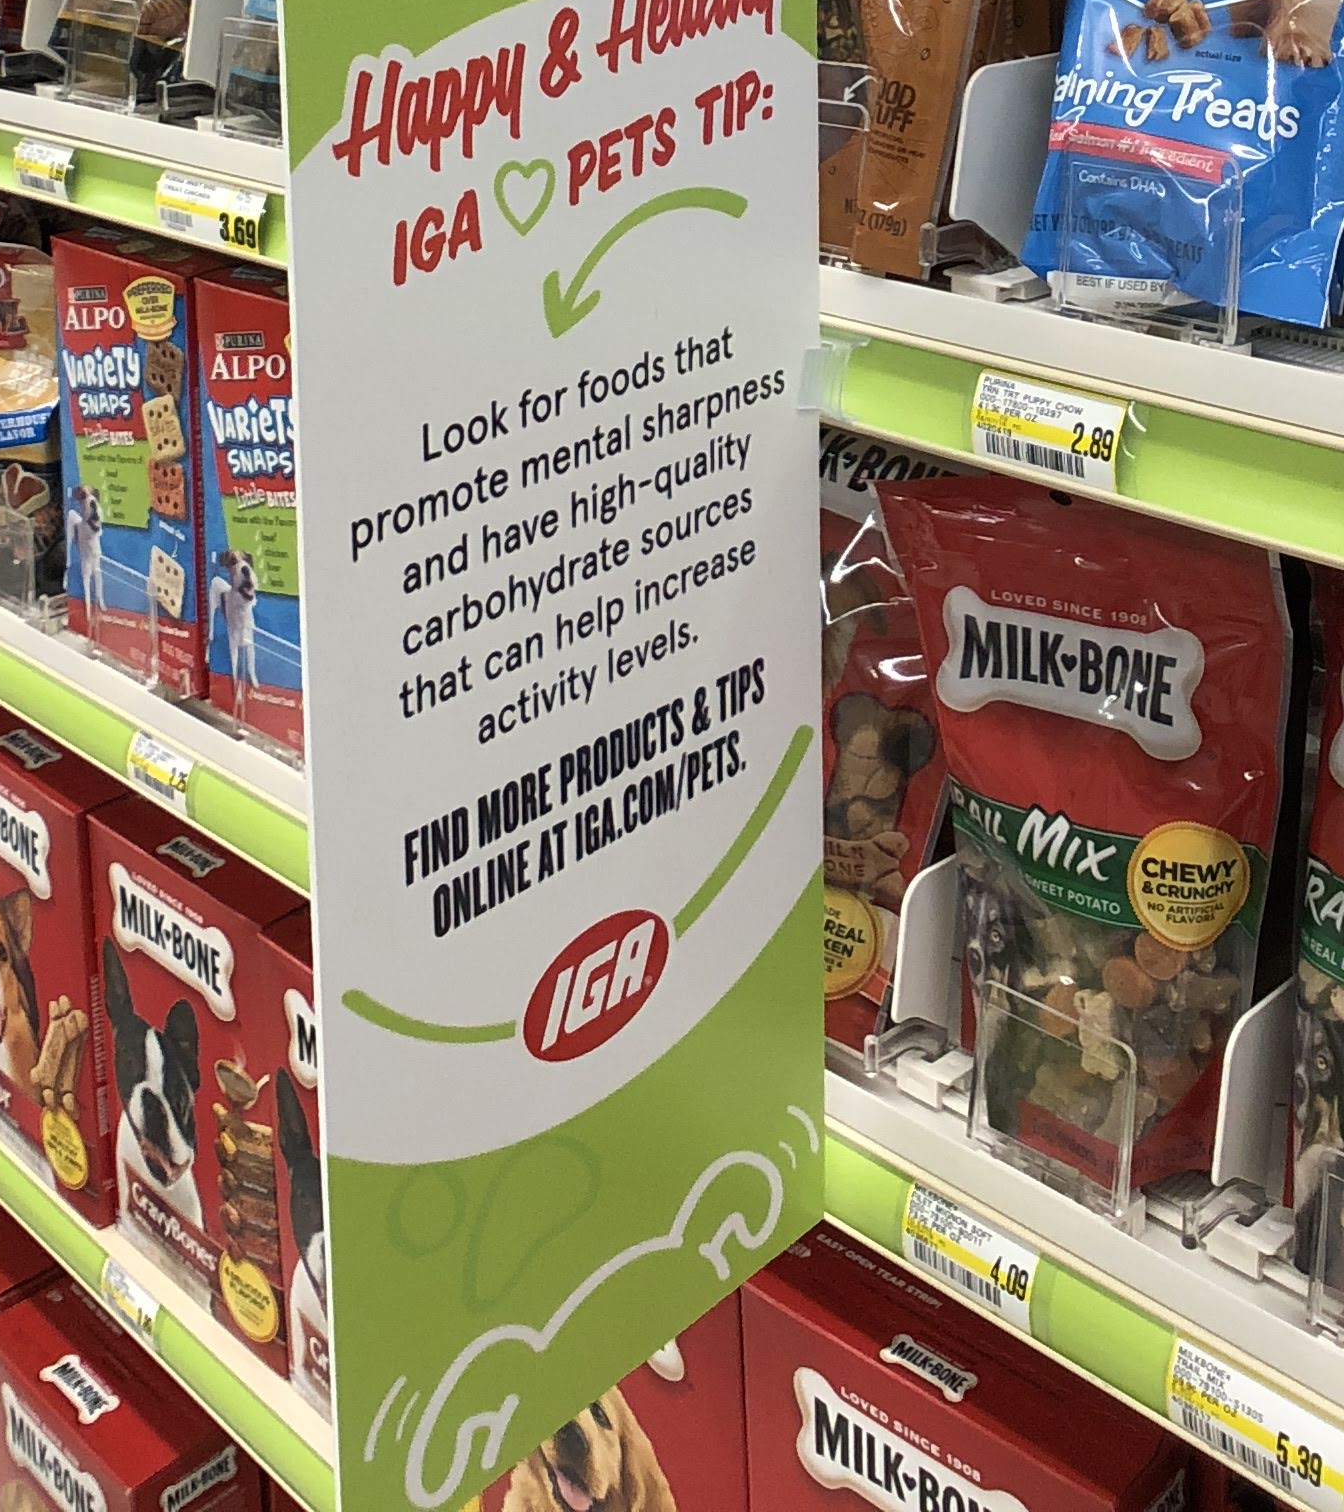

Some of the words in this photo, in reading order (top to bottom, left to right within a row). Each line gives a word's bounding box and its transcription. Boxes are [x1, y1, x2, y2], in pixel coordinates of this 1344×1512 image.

[331, 58, 527, 178] Happy
[539, 6, 583, 98] &
[1167, 72, 1301, 140] Treats
[218, 211, 258, 249] 3.69
[392, 188, 483, 287] IGA
[567, 106, 677, 207] PETS
[694, 68, 775, 146] TIP:
[64, 305, 126, 332] ALPO
[210, 353, 287, 382] ALPO
[77, 391, 132, 417] SNAPS
[421, 399, 510, 463] Look
[517, 384, 569, 429] for
[577, 351, 666, 403] foods
[674, 325, 735, 375] that
[1070, 421, 1115, 463] 2.89
[350, 463, 510, 563] promote
[520, 413, 633, 479] mental
[642, 368, 787, 444] sharpness
[402, 538, 470, 595] and
[481, 507, 559, 565] have
[569, 432, 753, 530] high-quality
[398, 656, 474, 720] that
[483, 631, 544, 680] can
[555, 591, 626, 650] help
[634, 538, 758, 611] increase
[402, 536, 631, 656] carbohydrate
[639, 488, 754, 556] sources
[477, 663, 597, 747] activity
[607, 619, 700, 686] levels.
[403, 804, 470, 887] FIND
[477, 763, 555, 844] MORE
[560, 702, 685, 806] PRODUCTS
[691, 685, 712, 737] &
[715, 657, 767, 728] TIPS
[432, 840, 532, 939] ONLINE
[536, 819, 568, 884] AT
[574, 728, 748, 861] IGA.COM/PETS.
[540, 918, 657, 1055] IGA
[989, 1254, 1030, 1303] 4.09
[1275, 1430, 1324, 1489] 5.39
